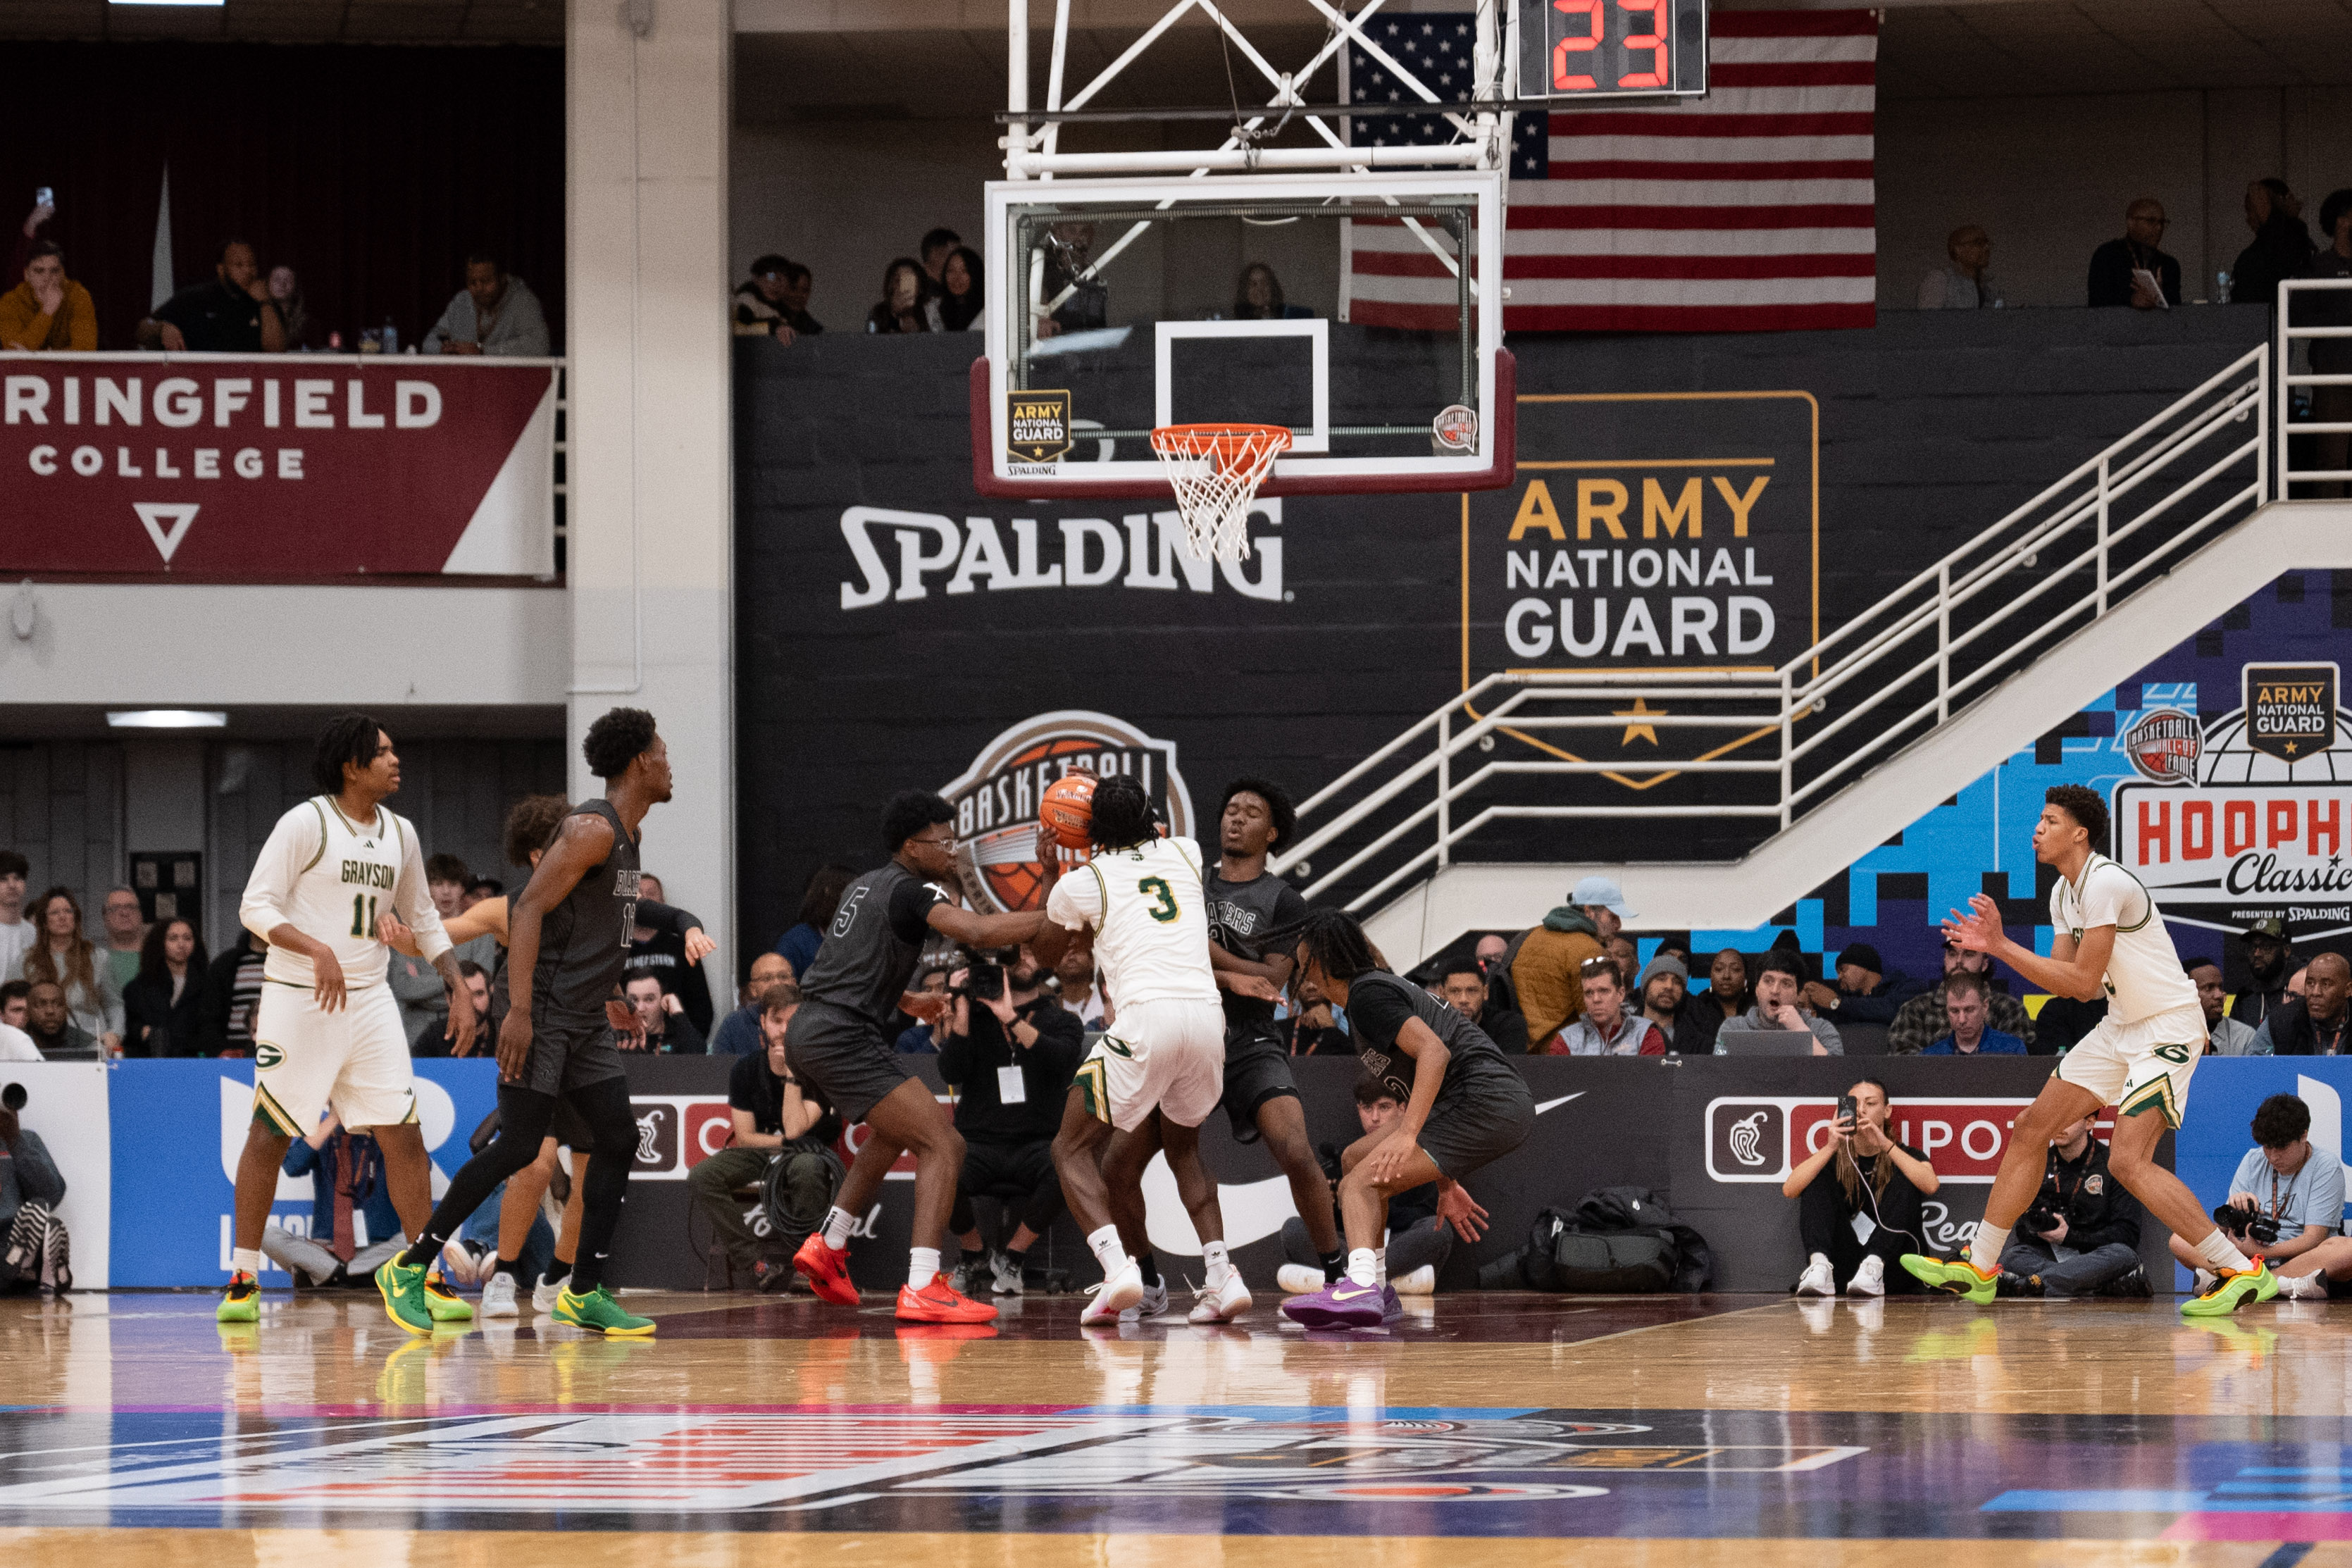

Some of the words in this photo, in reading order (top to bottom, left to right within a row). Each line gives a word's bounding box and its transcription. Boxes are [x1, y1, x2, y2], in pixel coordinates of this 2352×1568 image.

[1553, 0, 1667, 89] 23
[5, 375, 442, 428] RINGFIELD
[1014, 405, 1062, 418] ARMY
[1013, 428, 1063, 440] GUARD
[1014, 418, 1063, 428] NATIONAL
[28, 445, 305, 480] COLLEGE
[1008, 465, 1056, 476] SPALDING
[1507, 476, 1772, 541] ARMY
[841, 497, 1283, 610] SPALDING
[1507, 547, 1774, 588] NATIONAL
[1505, 596, 1775, 658] GUARD
[2257, 704, 2325, 716] NATIONAL
[2258, 686, 2324, 703] ARMY
[2132, 718, 2194, 745] BASKETBALL
[2257, 716, 2325, 733] GUARD
[2167, 754, 2195, 782] FAME
[2139, 799, 2352, 866] HOOPH
[341, 859, 394, 891] GRAYSON
[2227, 853, 2352, 895] Classic
[350, 892, 378, 940] 11
[833, 886, 869, 938] 5
[1138, 875, 1182, 924] 3
[2232, 911, 2273, 919] PRESENTED
[2276, 910, 2285, 919] BY
[2289, 906, 2350, 922] SPALDING
[1207, 901, 1256, 935] AZERS
[1922, 1201, 1979, 1251] Rea
